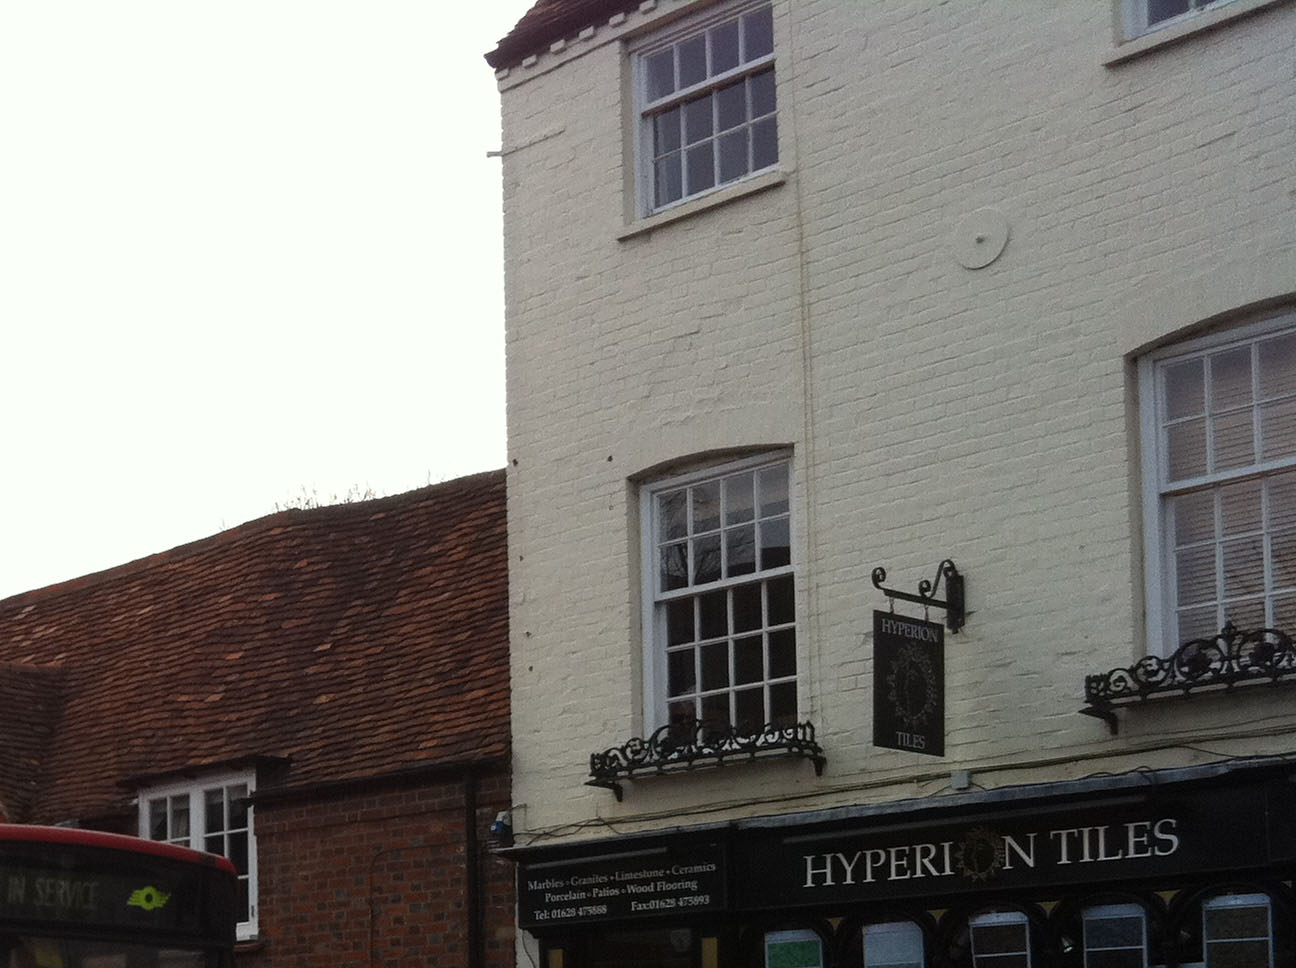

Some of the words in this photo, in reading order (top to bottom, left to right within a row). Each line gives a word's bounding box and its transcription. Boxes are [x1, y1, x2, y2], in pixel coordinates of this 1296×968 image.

[881, 619, 938, 643] HYPERION
[896, 731, 926, 750] TILES
[1050, 818, 1180, 865] TILES
[527, 880, 564, 891] Marbles
[570, 873, 608, 886] Granites
[615, 869, 665, 882] Limestone
[671, 862, 716, 876] Ceramics
[7, 876, 26, 904] IN
[35, 877, 99, 909] SERVICE
[545, 890, 586, 903] Porcelain
[592, 886, 620, 899] Patios
[626, 882, 654, 895] Wood
[656, 878, 699, 893] Flooring
[551, 907, 576, 919] 01628
